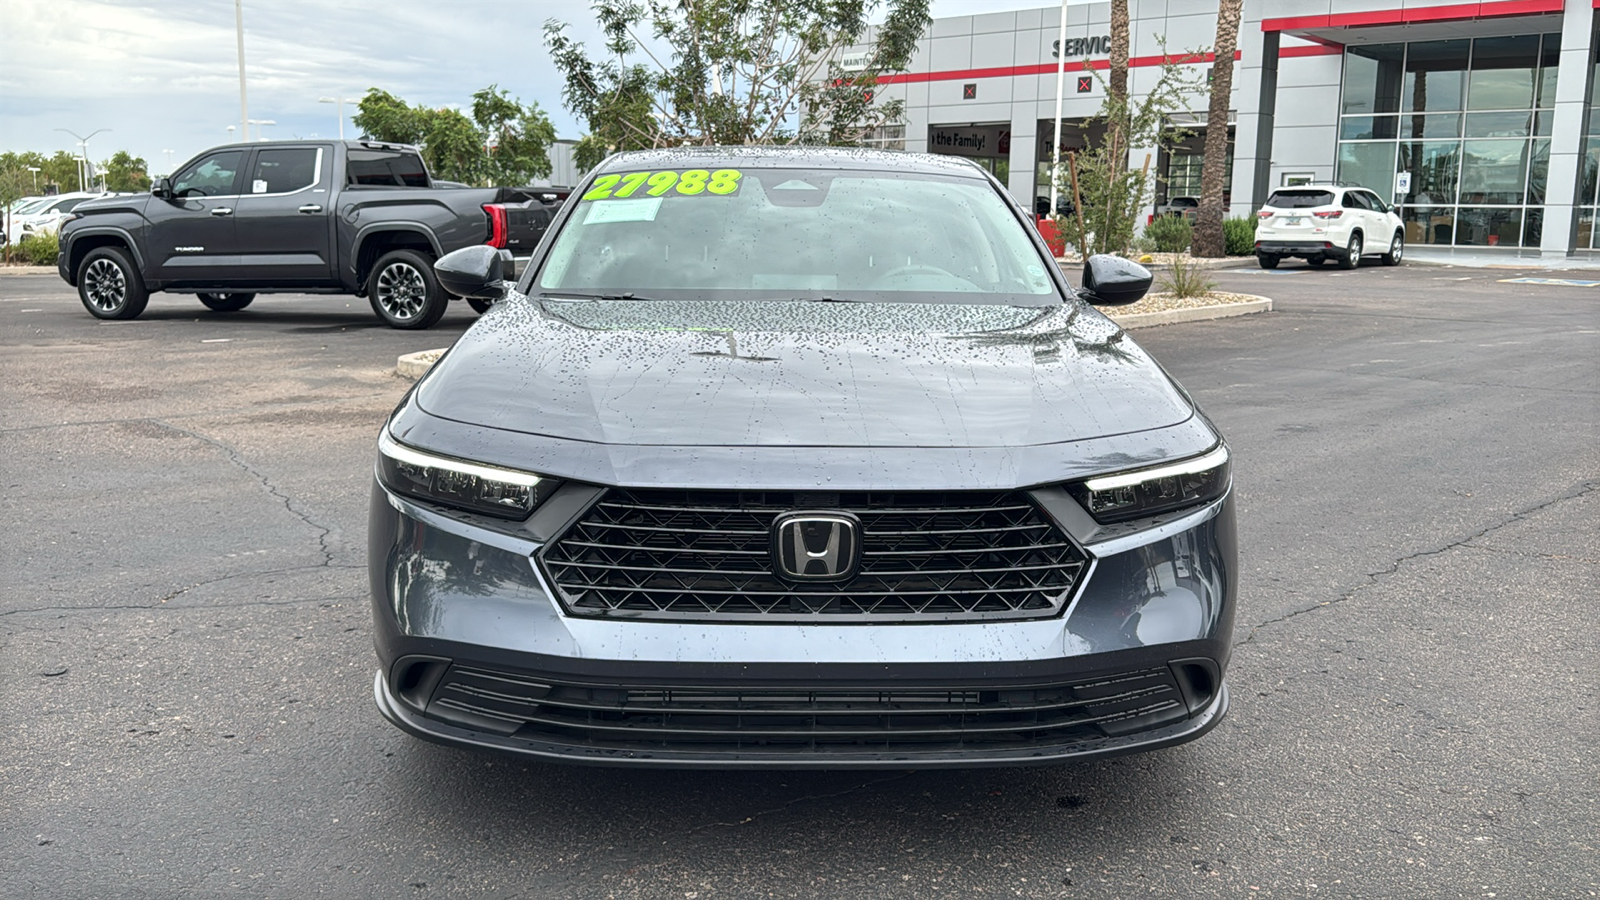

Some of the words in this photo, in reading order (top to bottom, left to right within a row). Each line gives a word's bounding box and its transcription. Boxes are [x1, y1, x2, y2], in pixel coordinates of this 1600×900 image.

[1052, 35, 1111, 58] SERVIC
[937, 131, 952, 146] the
[953, 132, 986, 151] Family!
[582, 169, 742, 200] 27988
